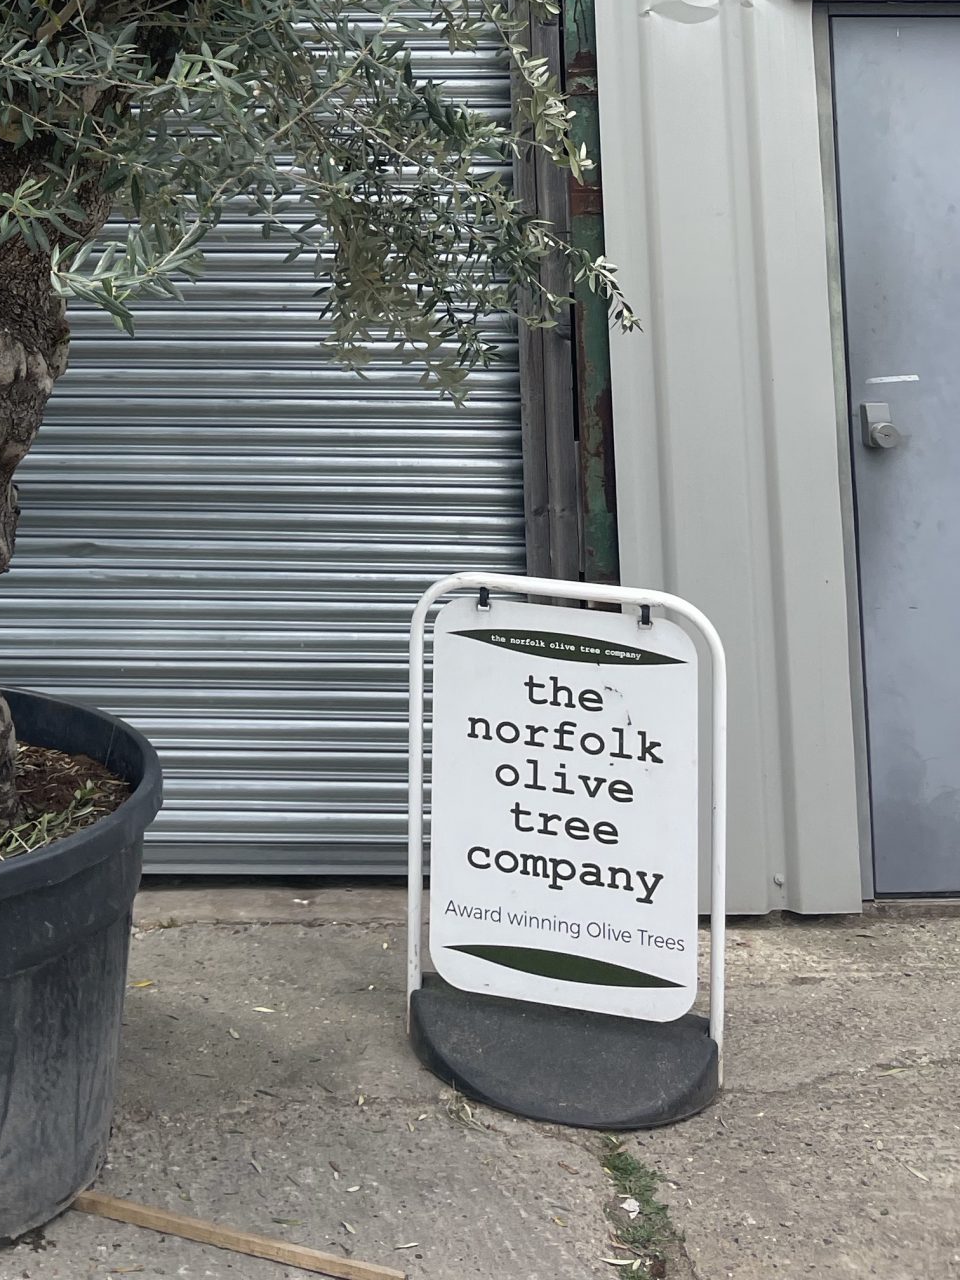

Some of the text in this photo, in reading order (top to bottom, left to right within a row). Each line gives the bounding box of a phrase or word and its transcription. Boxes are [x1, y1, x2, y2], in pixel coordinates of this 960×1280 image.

[491, 634, 641, 660] the norfolk olive tree company
[523, 674, 604, 712] the
[467, 715, 664, 765] norfolk
[495, 758, 634, 803] olive
[510, 801, 619, 845] tree
[467, 845, 664, 904] company
[444, 899, 685, 953] Award winning Olive Trees
